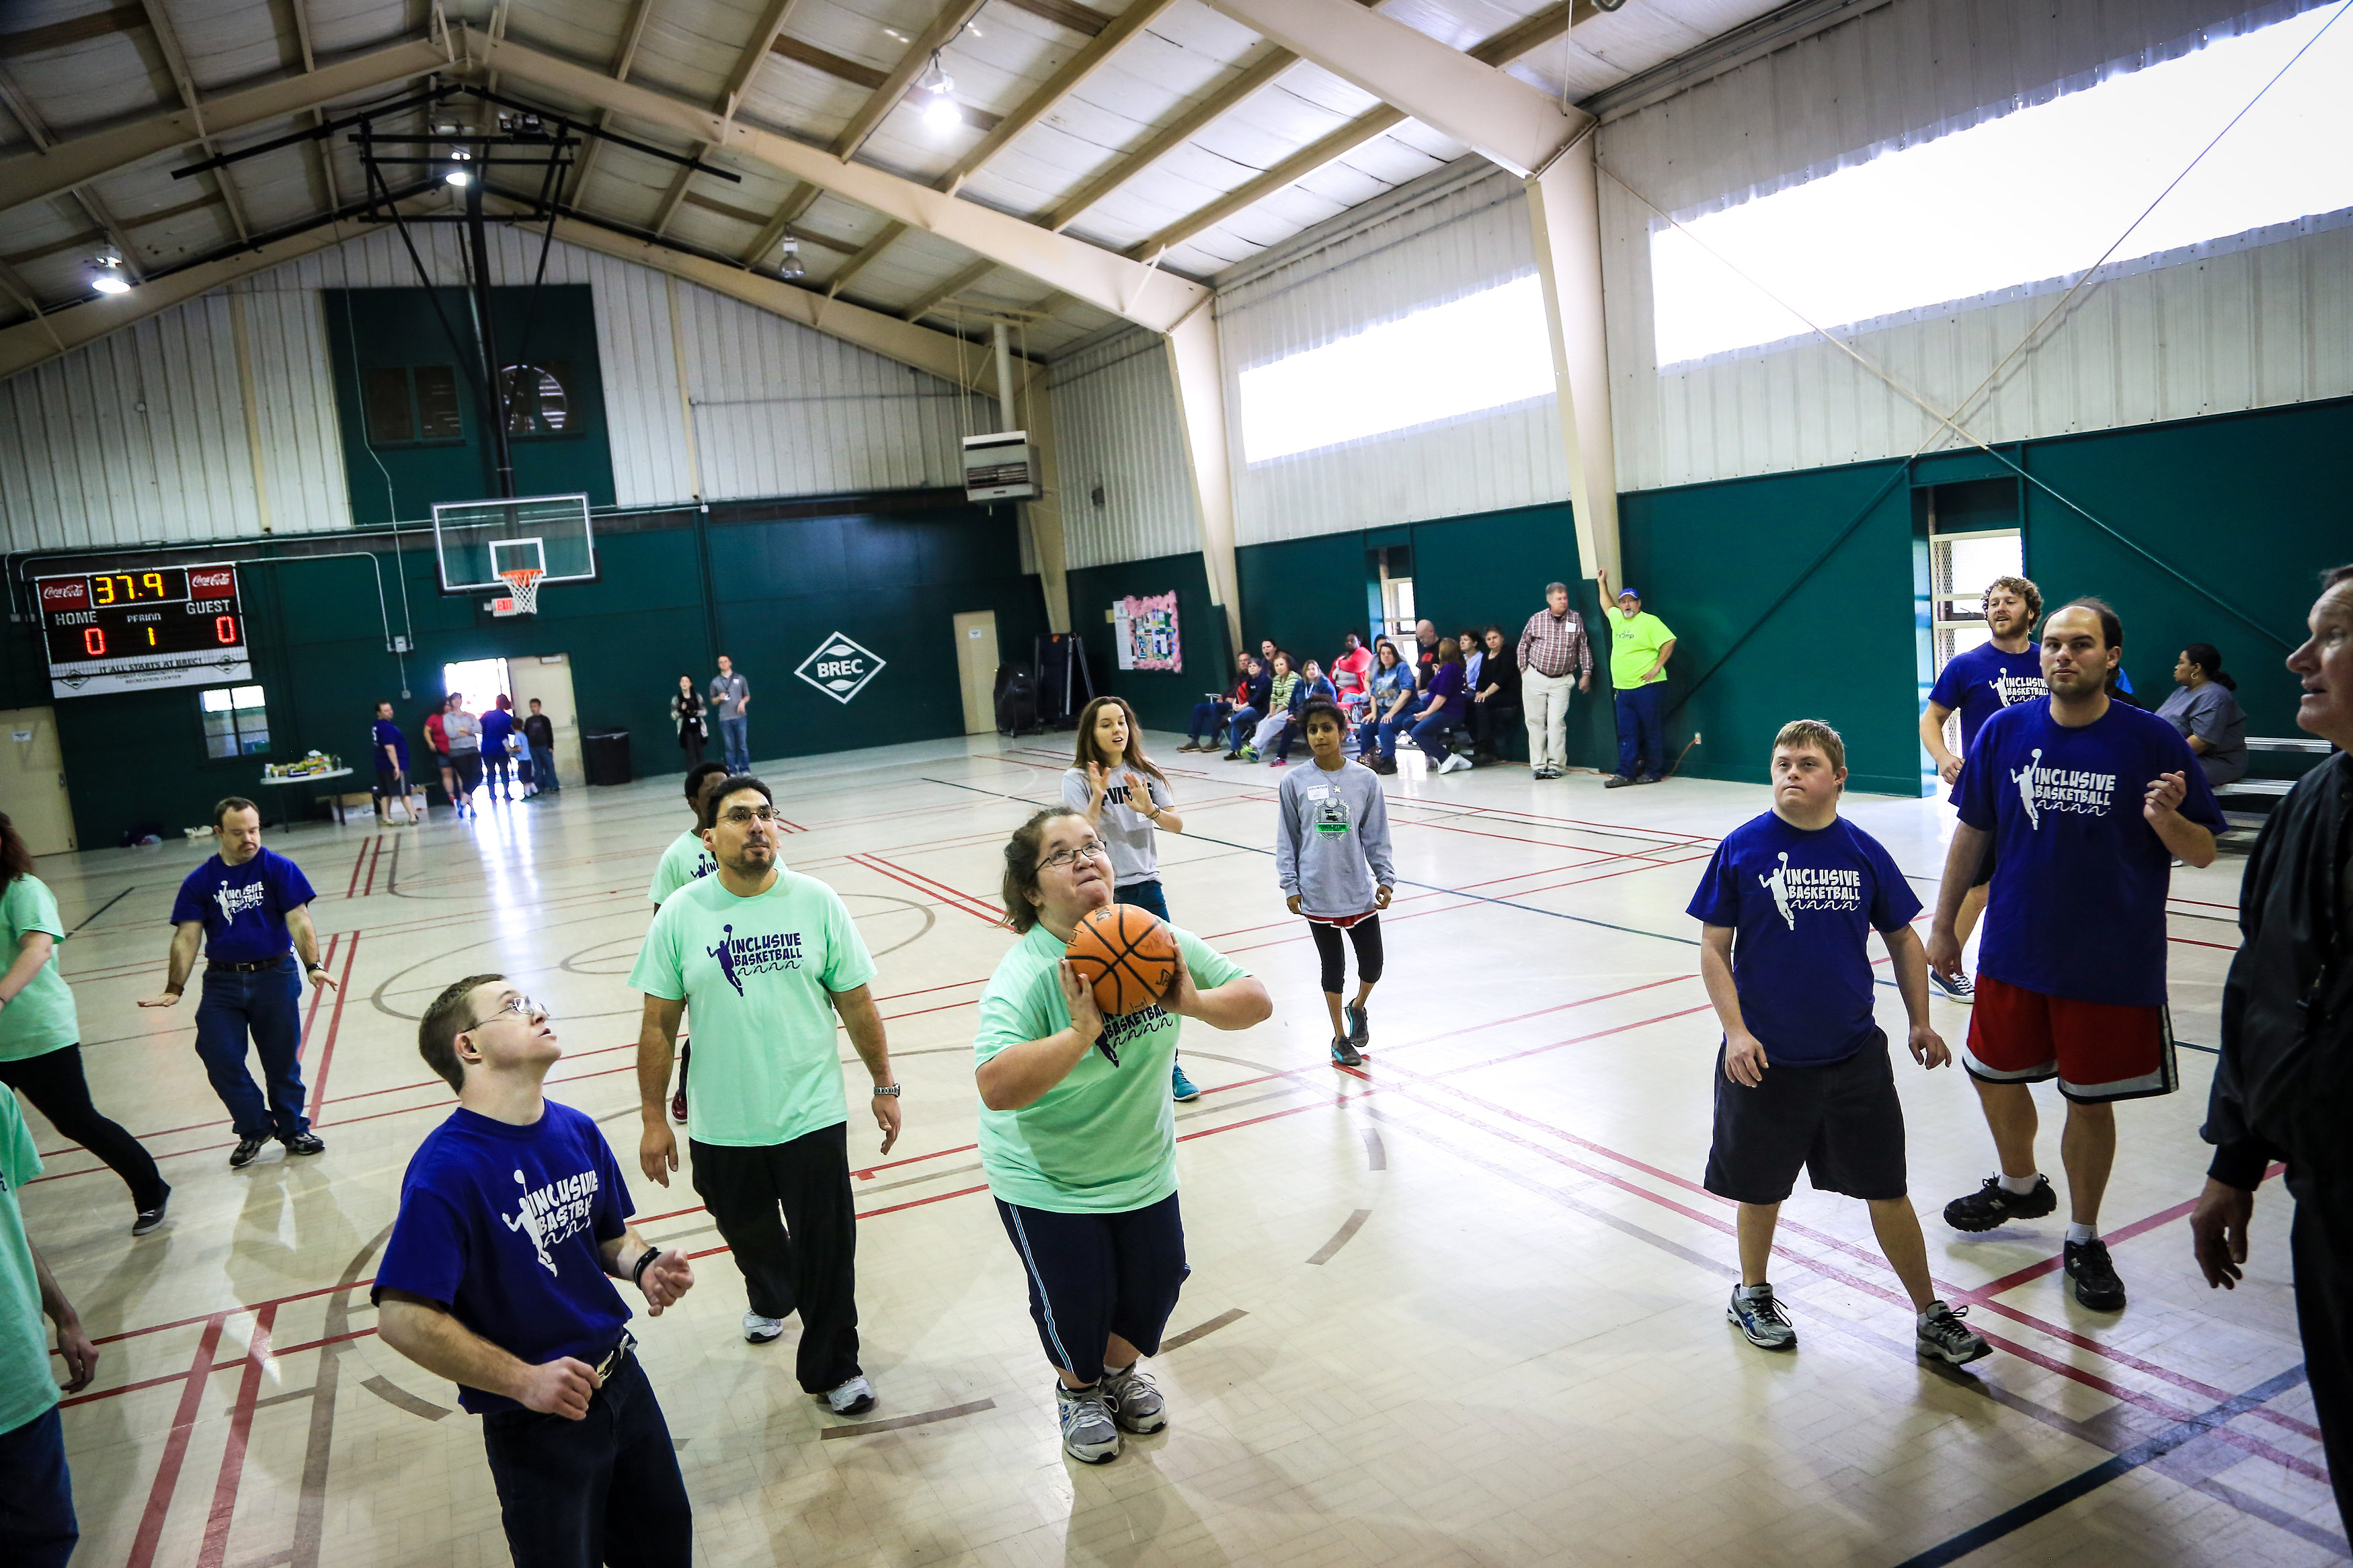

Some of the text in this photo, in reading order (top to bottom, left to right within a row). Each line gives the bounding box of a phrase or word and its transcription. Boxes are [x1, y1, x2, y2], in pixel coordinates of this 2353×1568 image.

[95, 573, 165, 604] 37.9
[192, 573, 230, 587] Coca-Cola
[43, 584, 83, 599] Coca-Cola
[186, 600, 230, 614] GUEST
[55, 611, 97, 626] HOME
[147, 627, 157, 646] 1
[214, 616, 236, 643] 0
[84, 628, 106, 655] 0
[817, 659, 864, 677] BREC
[2035, 768, 2116, 791] INCLUSIVE
[2035, 785, 2111, 805] BASKETBALL
[1786, 868, 1860, 886] INCLUSIVE
[1788, 886, 1860, 901] BASKETBALL
[731, 933, 801, 954] INCLUSIVE
[734, 948, 802, 966] BASKETBALL
